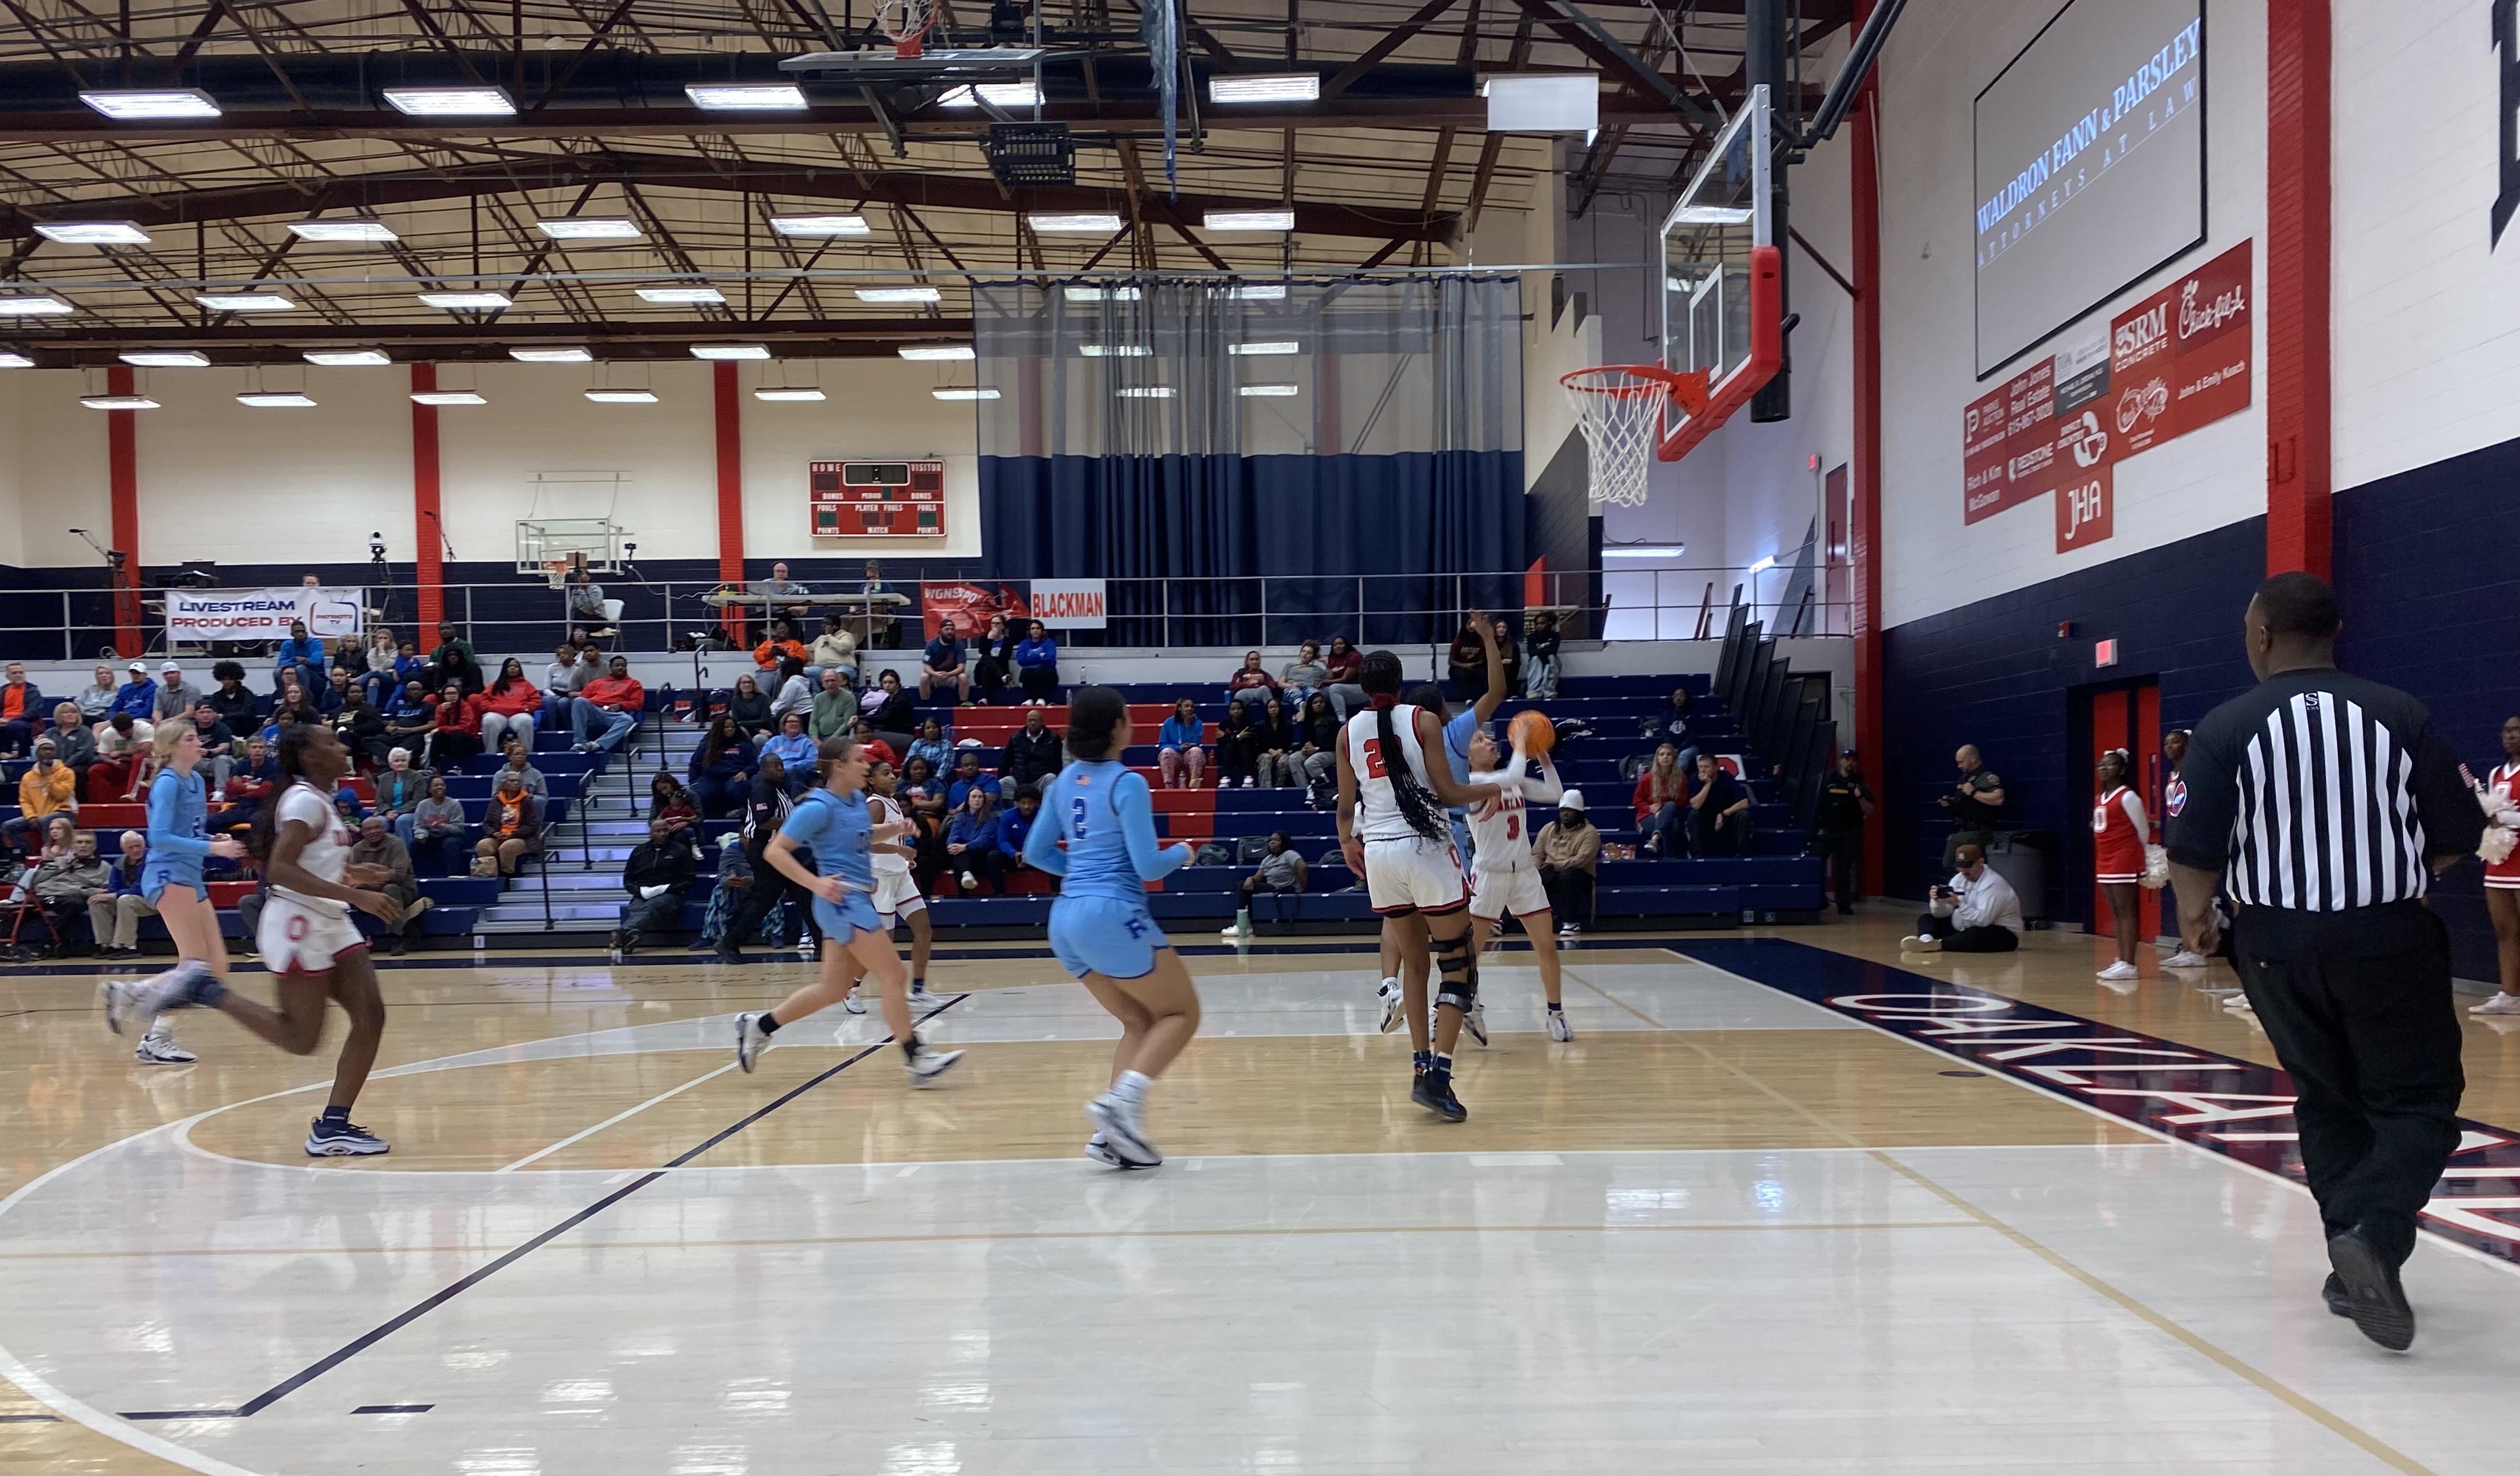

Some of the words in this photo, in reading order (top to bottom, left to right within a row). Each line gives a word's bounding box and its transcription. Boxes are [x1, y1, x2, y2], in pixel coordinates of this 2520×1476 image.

[1977, 150, 2050, 235] WALDRON
[2052, 108, 2099, 173] FANN
[2101, 108, 2112, 132] &
[2113, 17, 2200, 123] PARSLEY
[1977, 168, 2086, 268] ATTORNEYS
[2103, 134, 2128, 168] AT
[2148, 77, 2196, 131] LAW
[2126, 300, 2169, 354] SRM
[2115, 337, 2169, 374] CONCRETE
[812, 464, 841, 472] HOME
[911, 464, 941, 472] VISITOR
[179, 600, 295, 612] LIVESTREAM
[1033, 592, 1103, 618] BLACKMAN
[171, 616, 273, 628] PRODUCED
[1072, 796, 1089, 841] 2
[1507, 814, 1520, 841] 3
